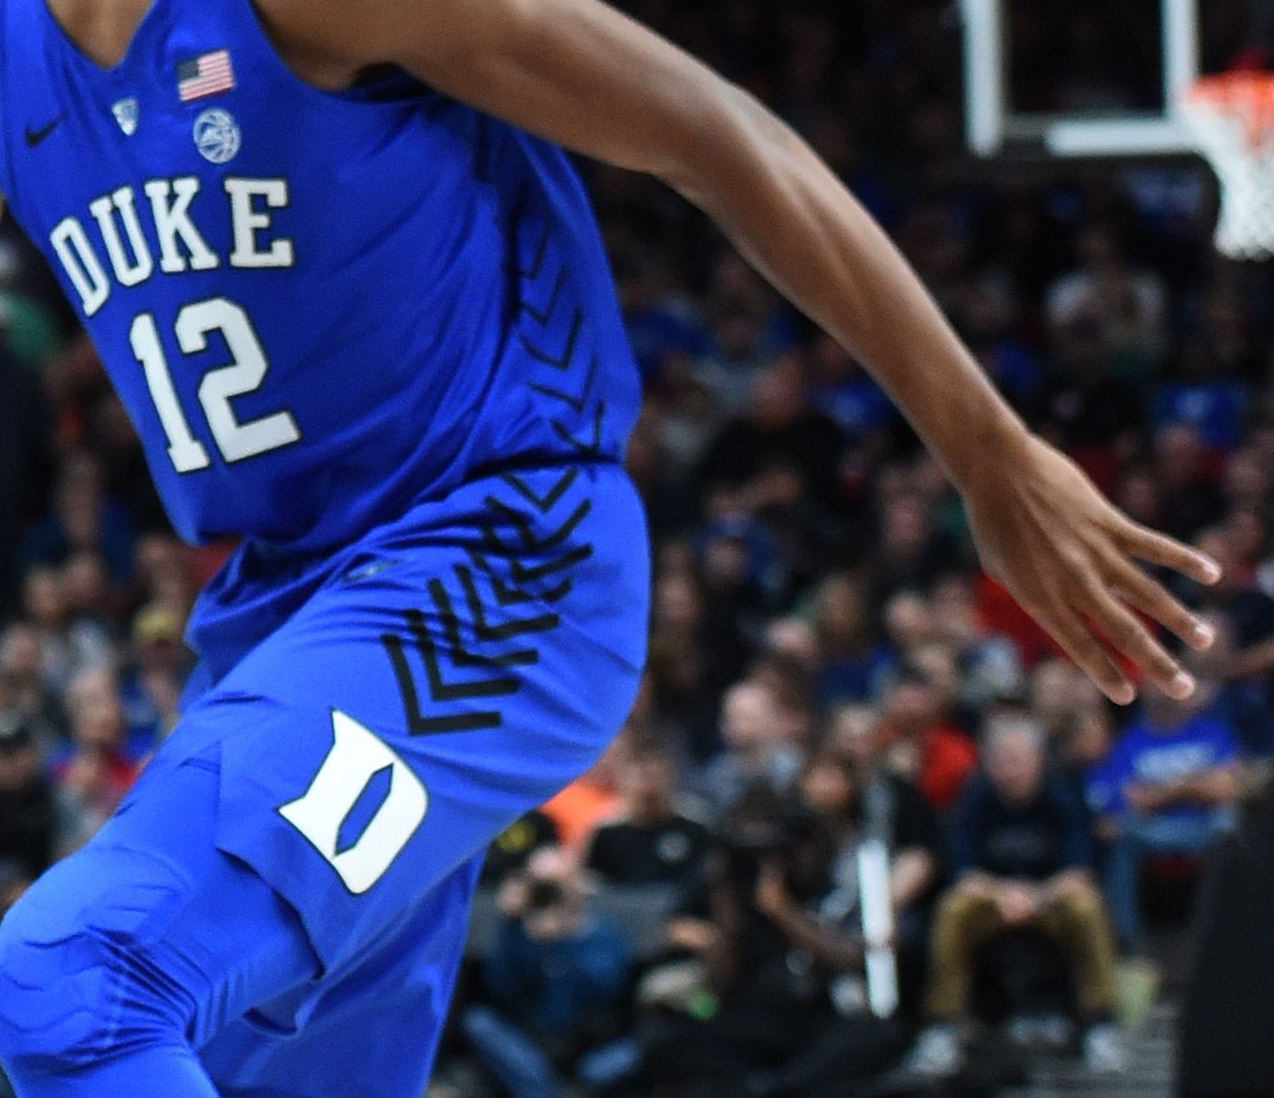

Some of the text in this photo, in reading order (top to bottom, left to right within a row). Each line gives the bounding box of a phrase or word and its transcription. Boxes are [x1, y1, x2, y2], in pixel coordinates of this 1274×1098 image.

[49, 175, 295, 318] DUKE
[128, 297, 301, 474] 12
[274, 706, 430, 897] D
